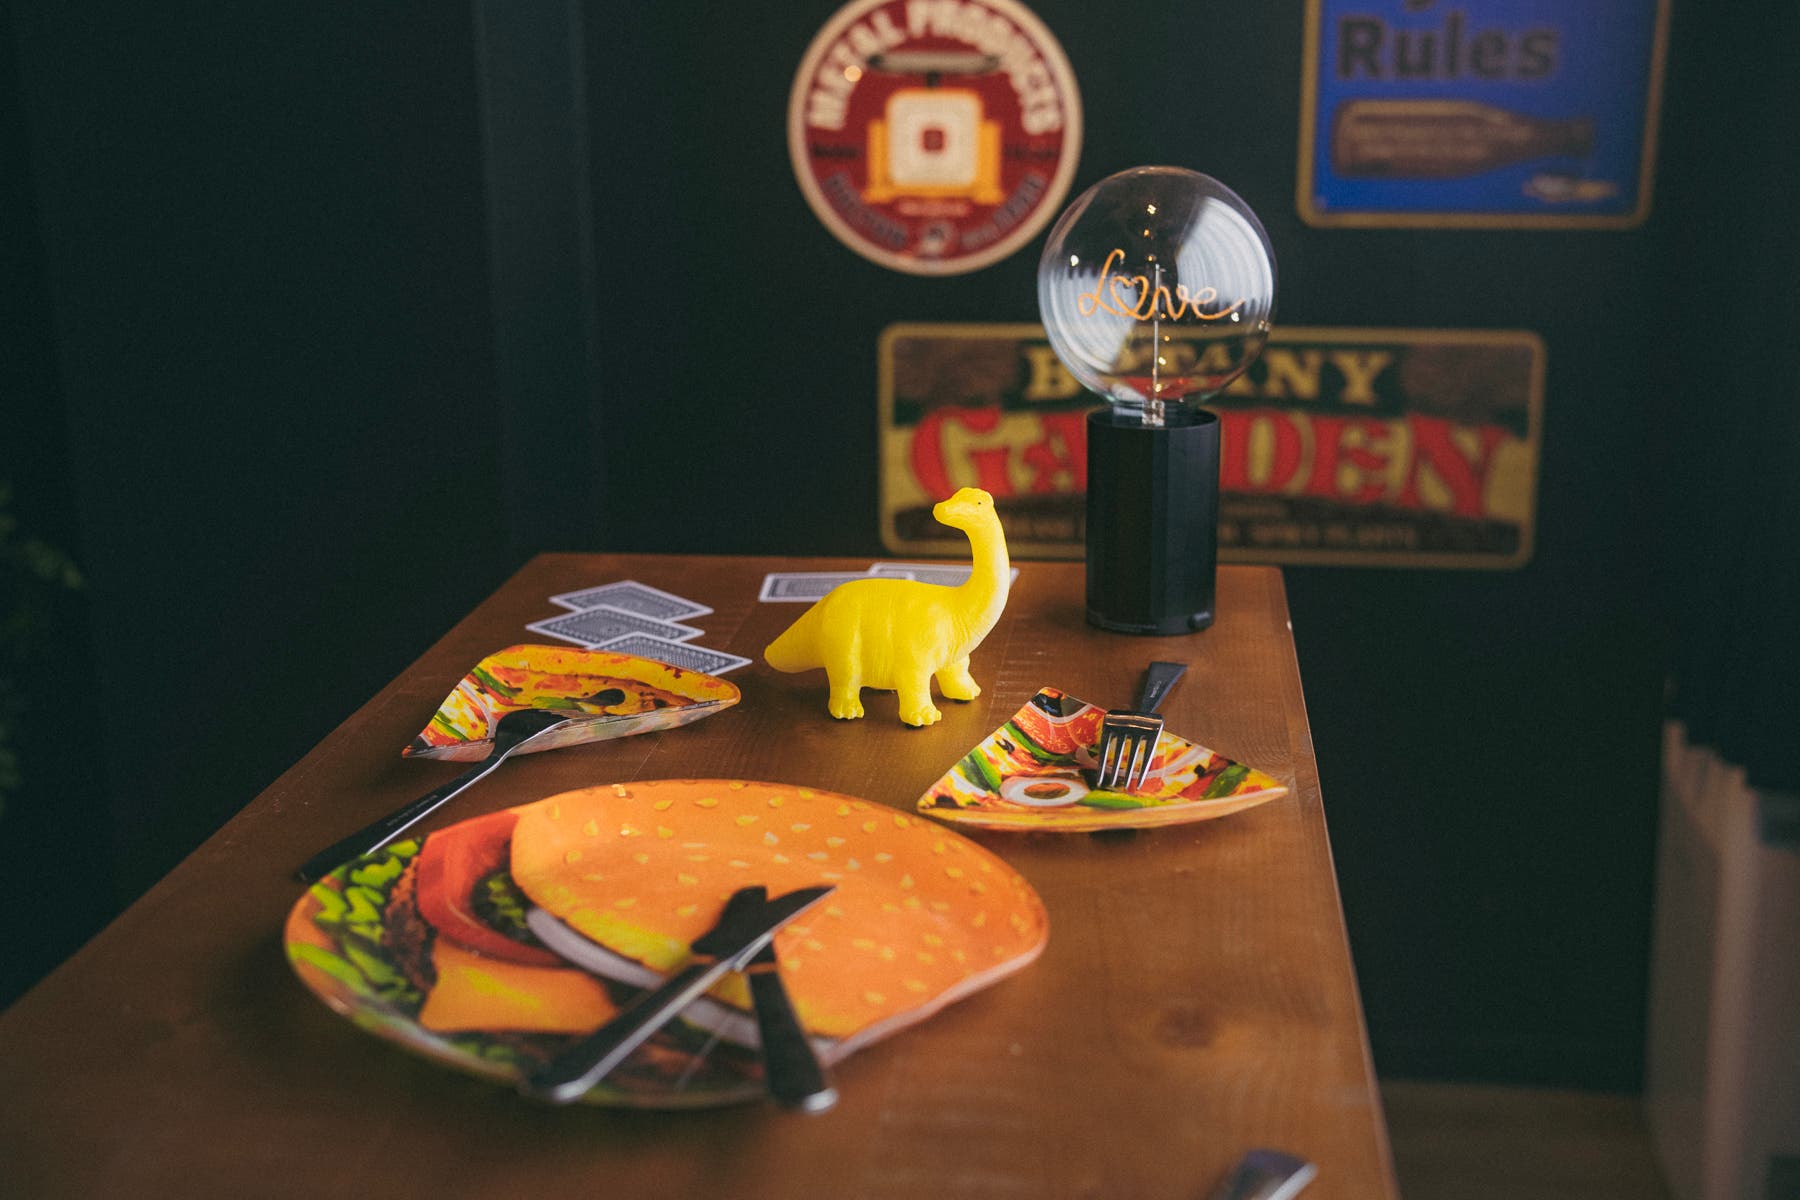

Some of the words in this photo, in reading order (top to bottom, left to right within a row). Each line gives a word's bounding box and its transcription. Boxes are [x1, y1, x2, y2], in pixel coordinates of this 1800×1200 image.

[808, 9, 905, 131] METAL
[905, 0, 1063, 135] PRODUCTS
[1336, 10, 1558, 79] Rules
[1077, 248, 1246, 322] Love
[1025, 342, 1391, 405] BTANY
[911, 406, 1511, 517] GADEN
